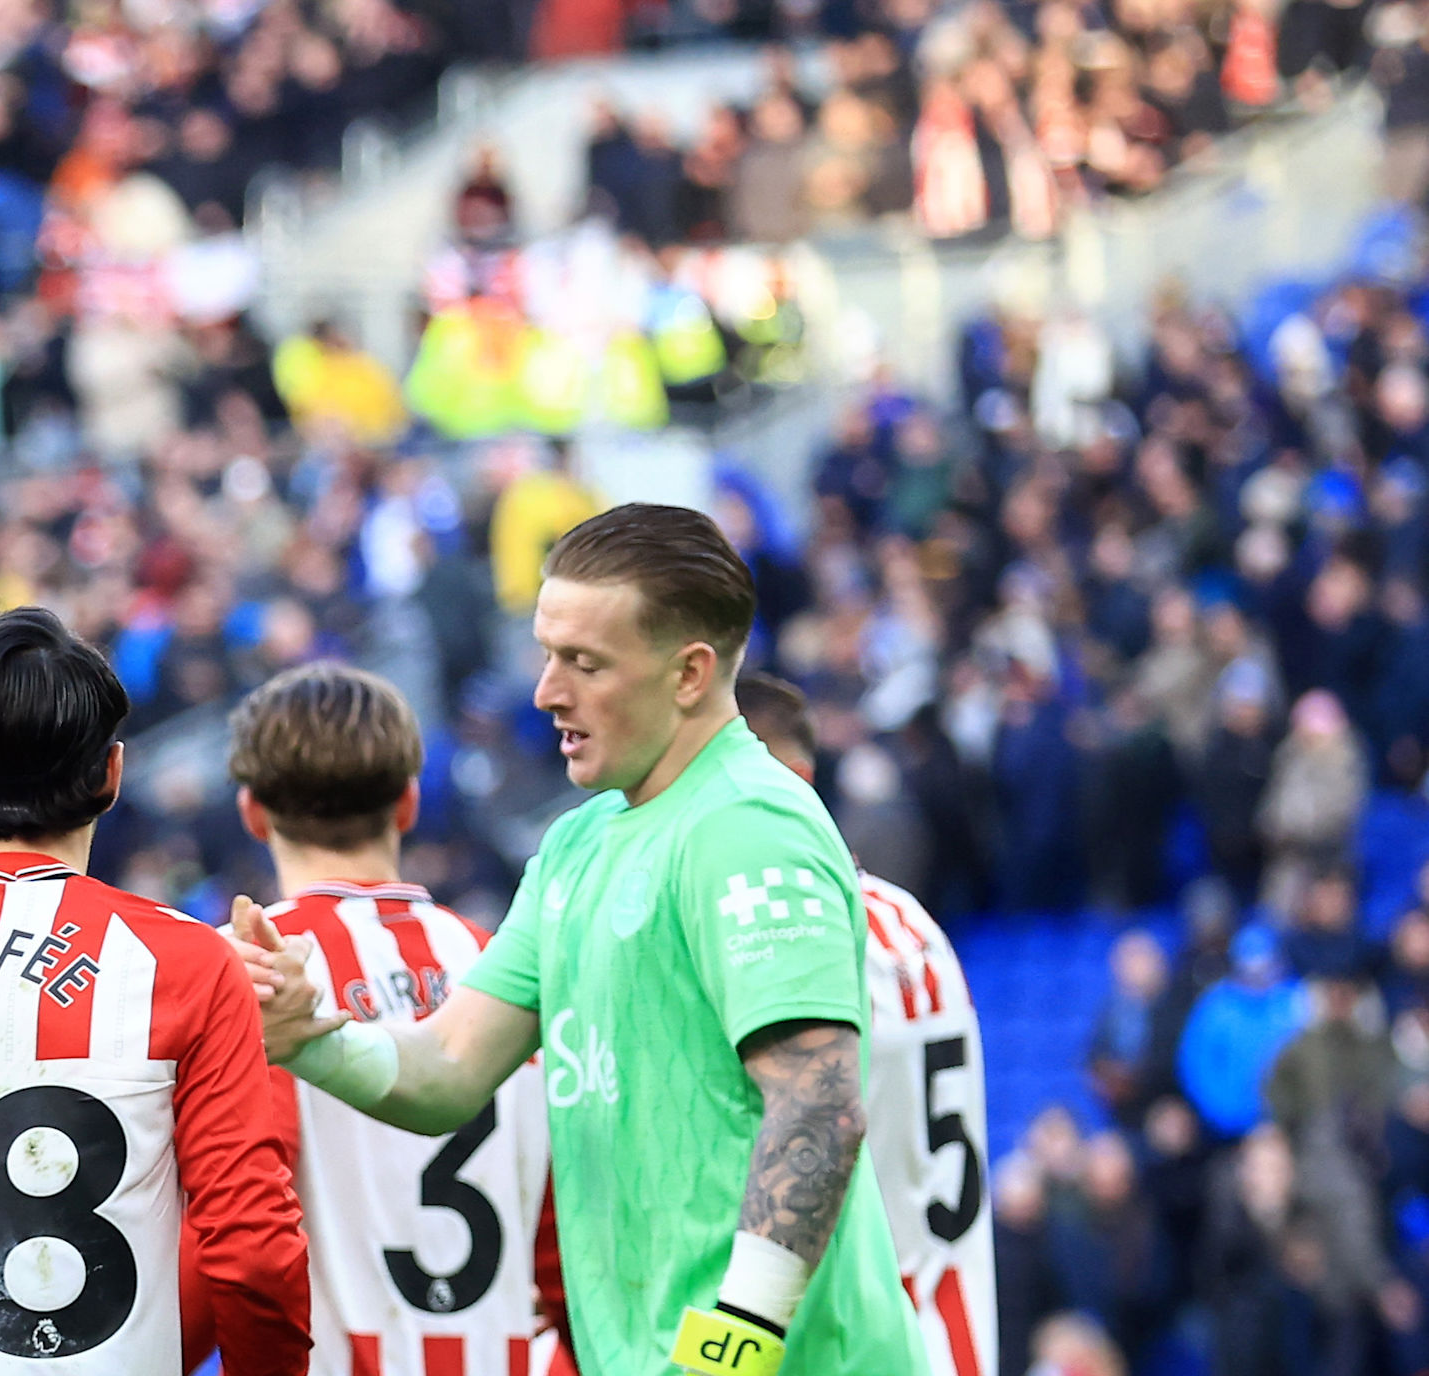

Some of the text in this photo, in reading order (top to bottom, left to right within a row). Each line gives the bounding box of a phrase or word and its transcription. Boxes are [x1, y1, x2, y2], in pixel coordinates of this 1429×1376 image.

[726, 925, 826, 951] Christopher
[730, 944, 775, 967] Ward
[345, 967, 452, 1022] CIRK
[924, 1036, 981, 1243] 5
[382, 1096, 502, 1313] 3
[700, 1331, 761, 1368] JP
